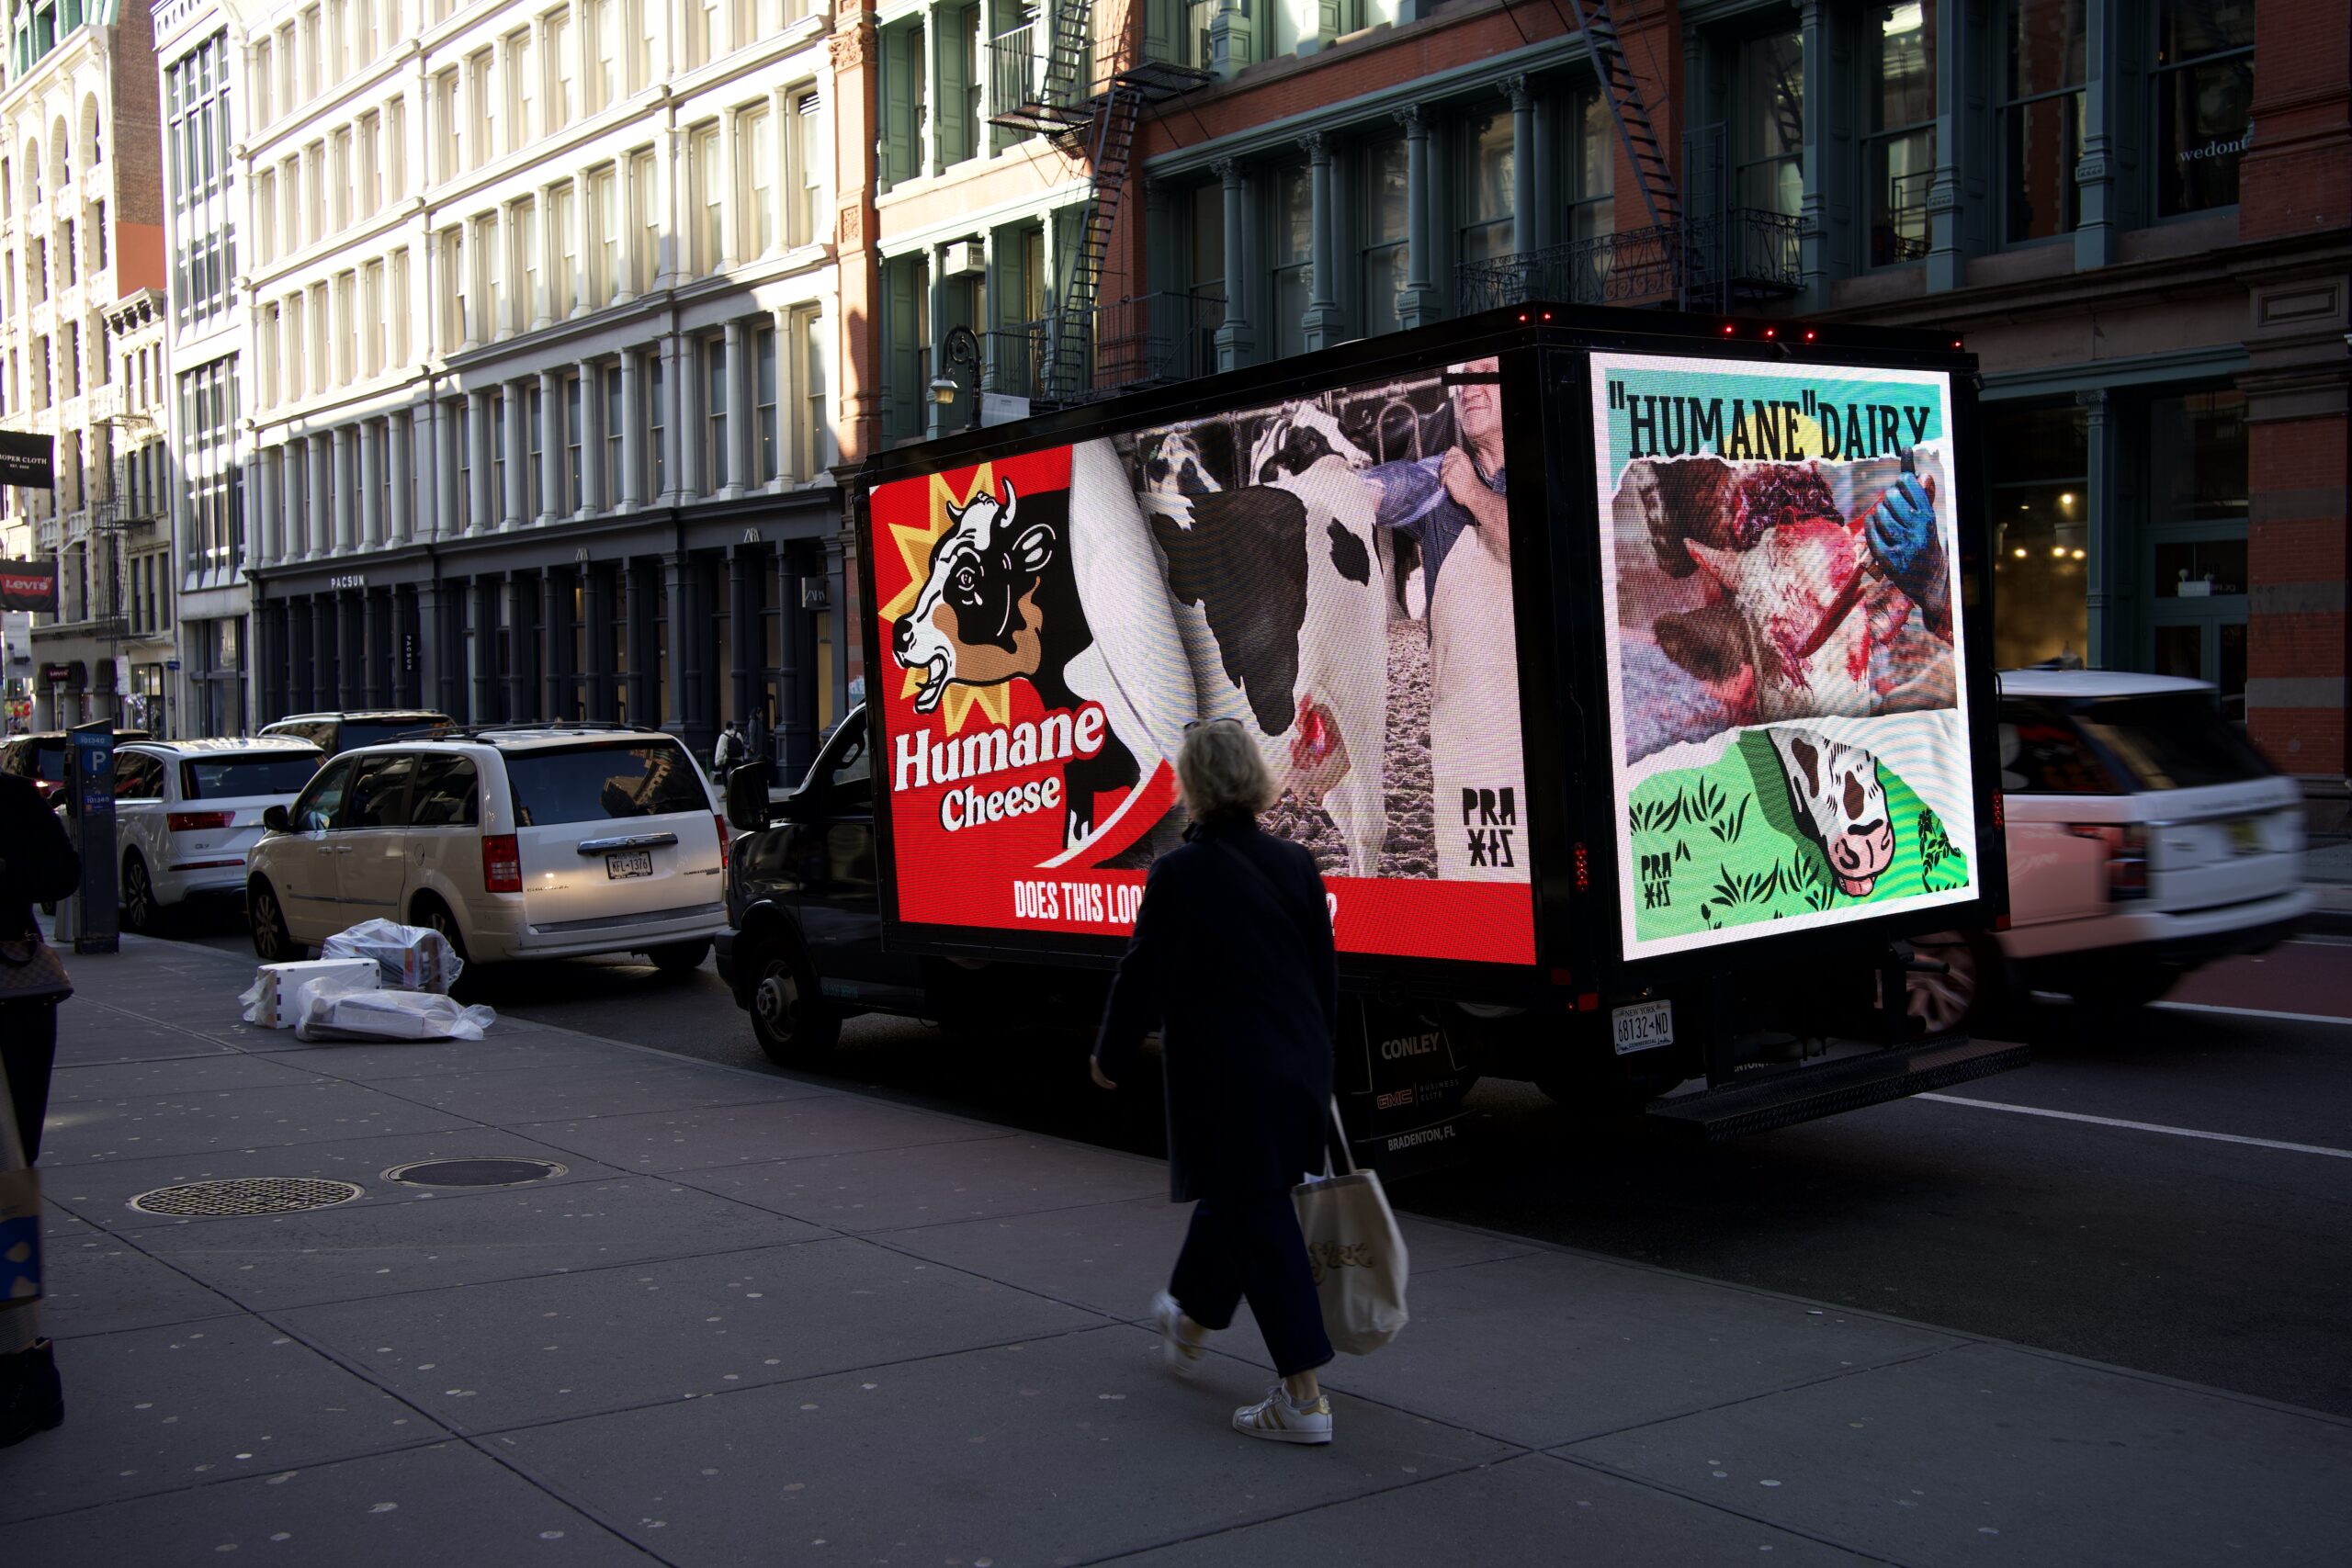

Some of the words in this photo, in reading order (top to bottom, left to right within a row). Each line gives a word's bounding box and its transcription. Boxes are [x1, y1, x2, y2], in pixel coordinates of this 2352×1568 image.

[1817, 402, 1930, 461] DAIRY
[22, 457, 47, 465] CLOTH
[331, 574, 364, 589] PACSUN
[92, 750, 107, 772] P
[893, 706, 1104, 792] Humane
[941, 776, 1061, 831] Cheese
[1014, 880, 1057, 919] DOES
[1060, 882, 1103, 922] THIS
[1106, 884, 1146, 924] LOO
[1624, 1009, 1639, 1018] NEW
[1640, 1006, 1657, 1015] YORK
[1381, 1032, 1441, 1060] CONLEY
[1376, 1089, 1413, 1110] GMC
[1419, 1090, 1444, 1102] ELITE
[1387, 1126, 1444, 1152] BRADENTON,
[1443, 1124, 1456, 1139] FL
